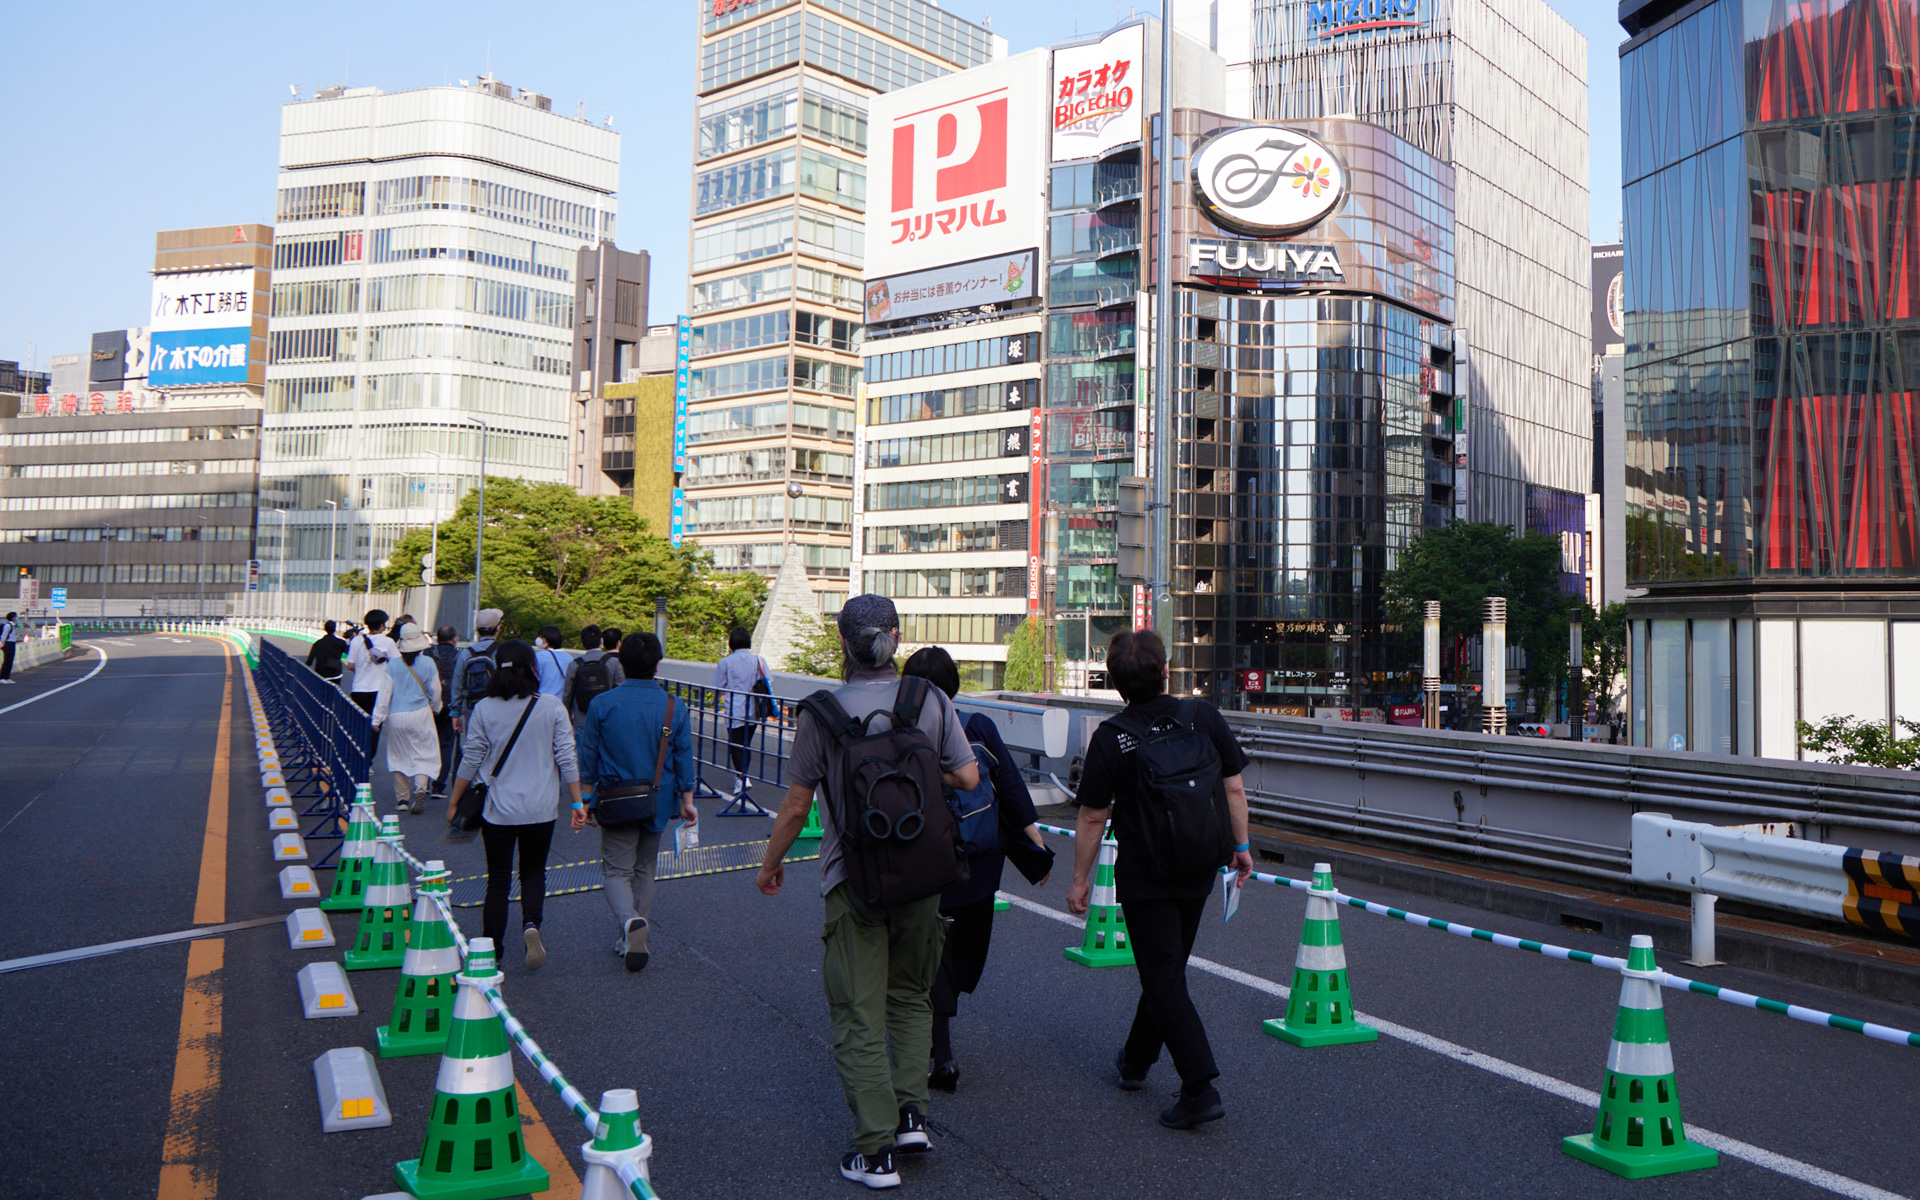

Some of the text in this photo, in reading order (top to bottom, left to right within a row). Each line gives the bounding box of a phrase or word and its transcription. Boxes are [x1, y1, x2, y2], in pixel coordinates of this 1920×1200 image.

[1308, 0, 1417, 27] MIZUHO
[1058, 60, 1131, 99] カラオケ
[1055, 86, 1133, 128] BIG ECHO
[891, 199, 1007, 245] プリマハム
[1190, 244, 1343, 275] FUJIYA
[175, 291, 247, 315] 木下工務店
[169, 343, 247, 369] 木下の介護
[1032, 415, 1042, 464] カラオケ
[1561, 531, 1581, 574] GAP
[1399, 708, 1416, 716] FUJIYA
